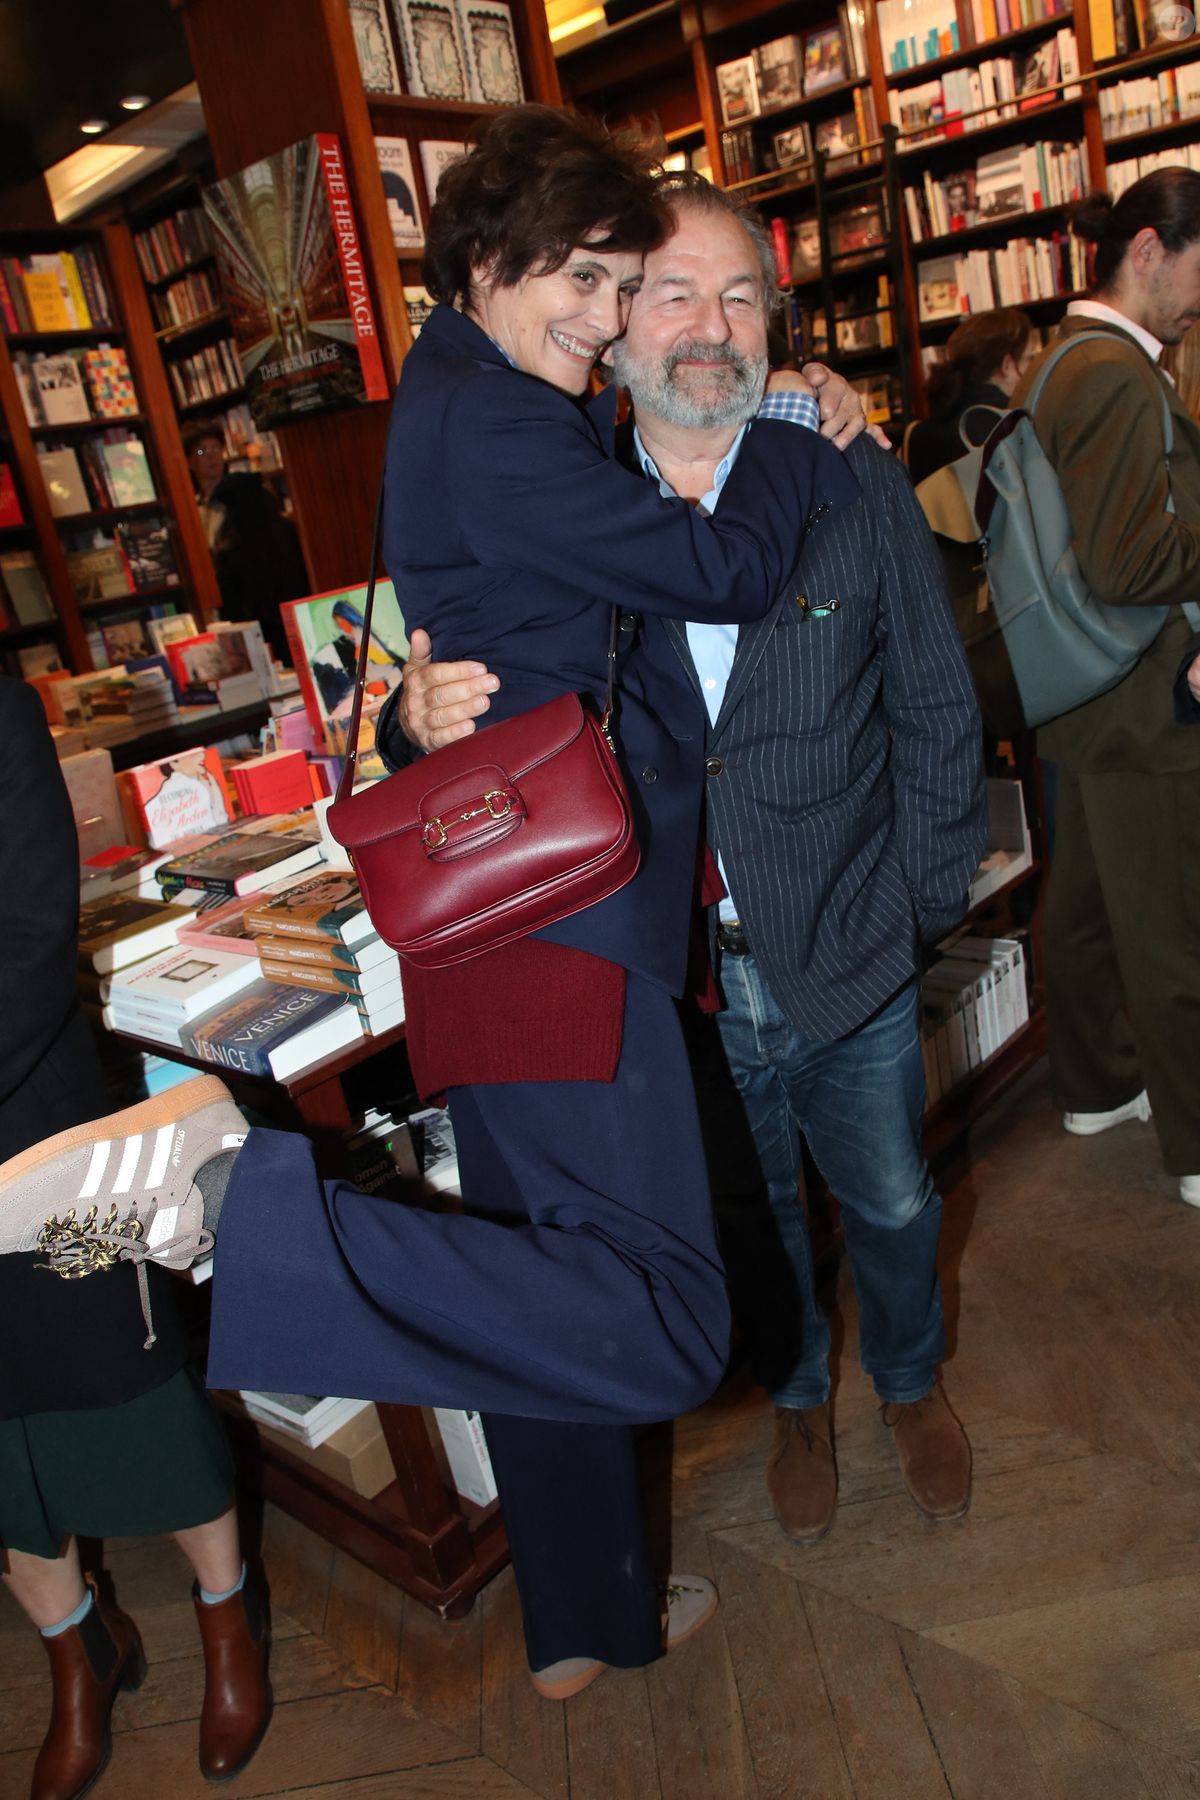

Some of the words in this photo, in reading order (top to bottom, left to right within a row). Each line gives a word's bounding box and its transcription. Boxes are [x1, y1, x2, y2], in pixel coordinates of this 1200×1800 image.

[322, 143, 347, 194] THE
[333, 199, 374, 338] HERMITAGE
[259, 361, 279, 381] THE
[280, 342, 340, 374] HERMITAGE
[151, 789, 200, 827] Elizabeth
[175, 807, 209, 829] Arden
[234, 992, 320, 1042] VENICE
[190, 1038, 251, 1072] VENICE
[174, 1127, 187, 1159] SPEZIAL
